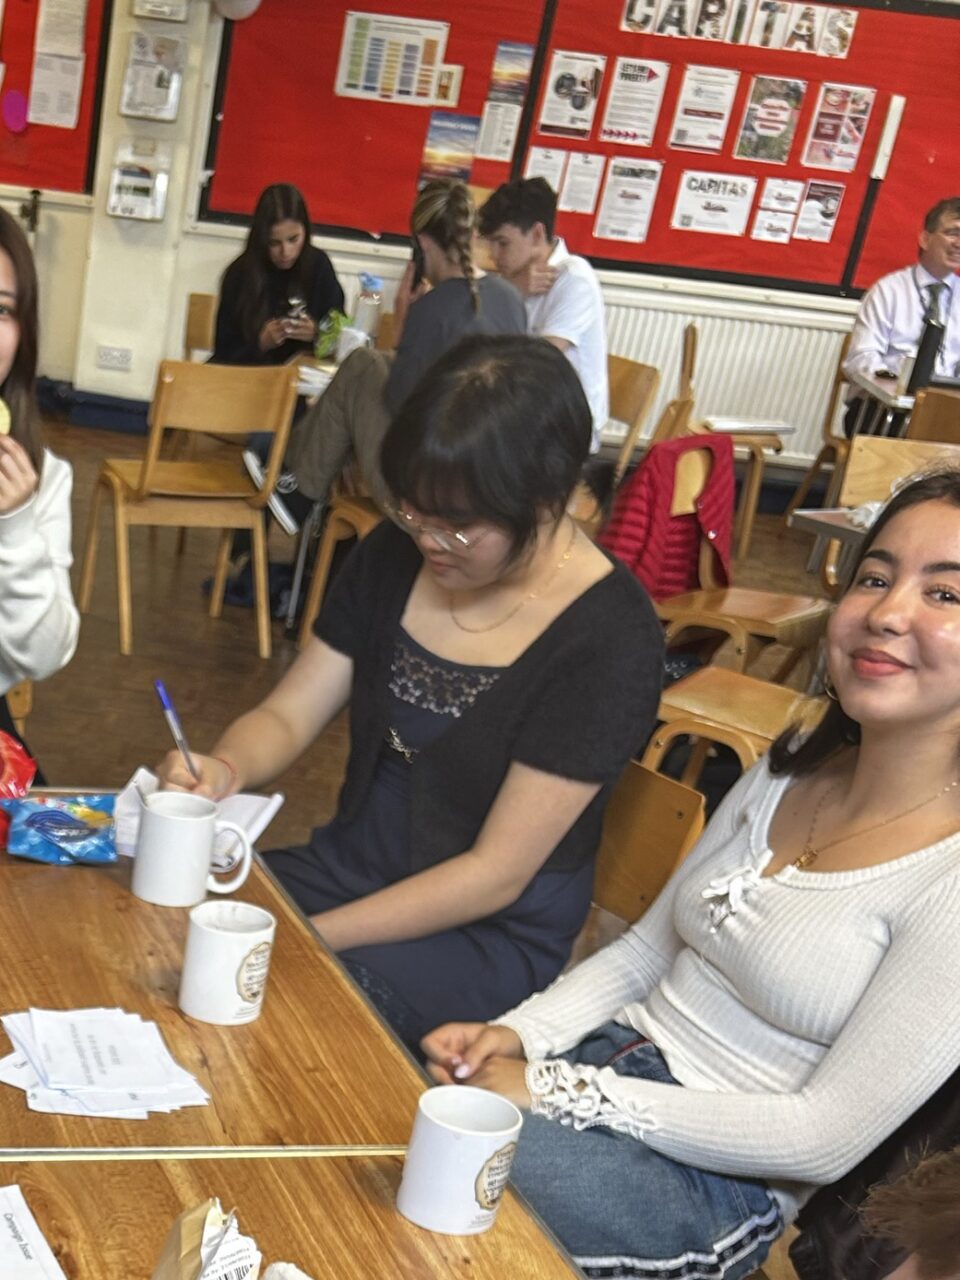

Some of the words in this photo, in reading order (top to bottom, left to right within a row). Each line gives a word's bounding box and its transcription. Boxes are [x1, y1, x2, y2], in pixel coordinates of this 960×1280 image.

[624, 0, 855, 57] CARITAS
[686, 176, 748, 197] CARITAS
[3, 1212, 24, 1242] Campaign
[18, 1241, 33, 1261] Issue
